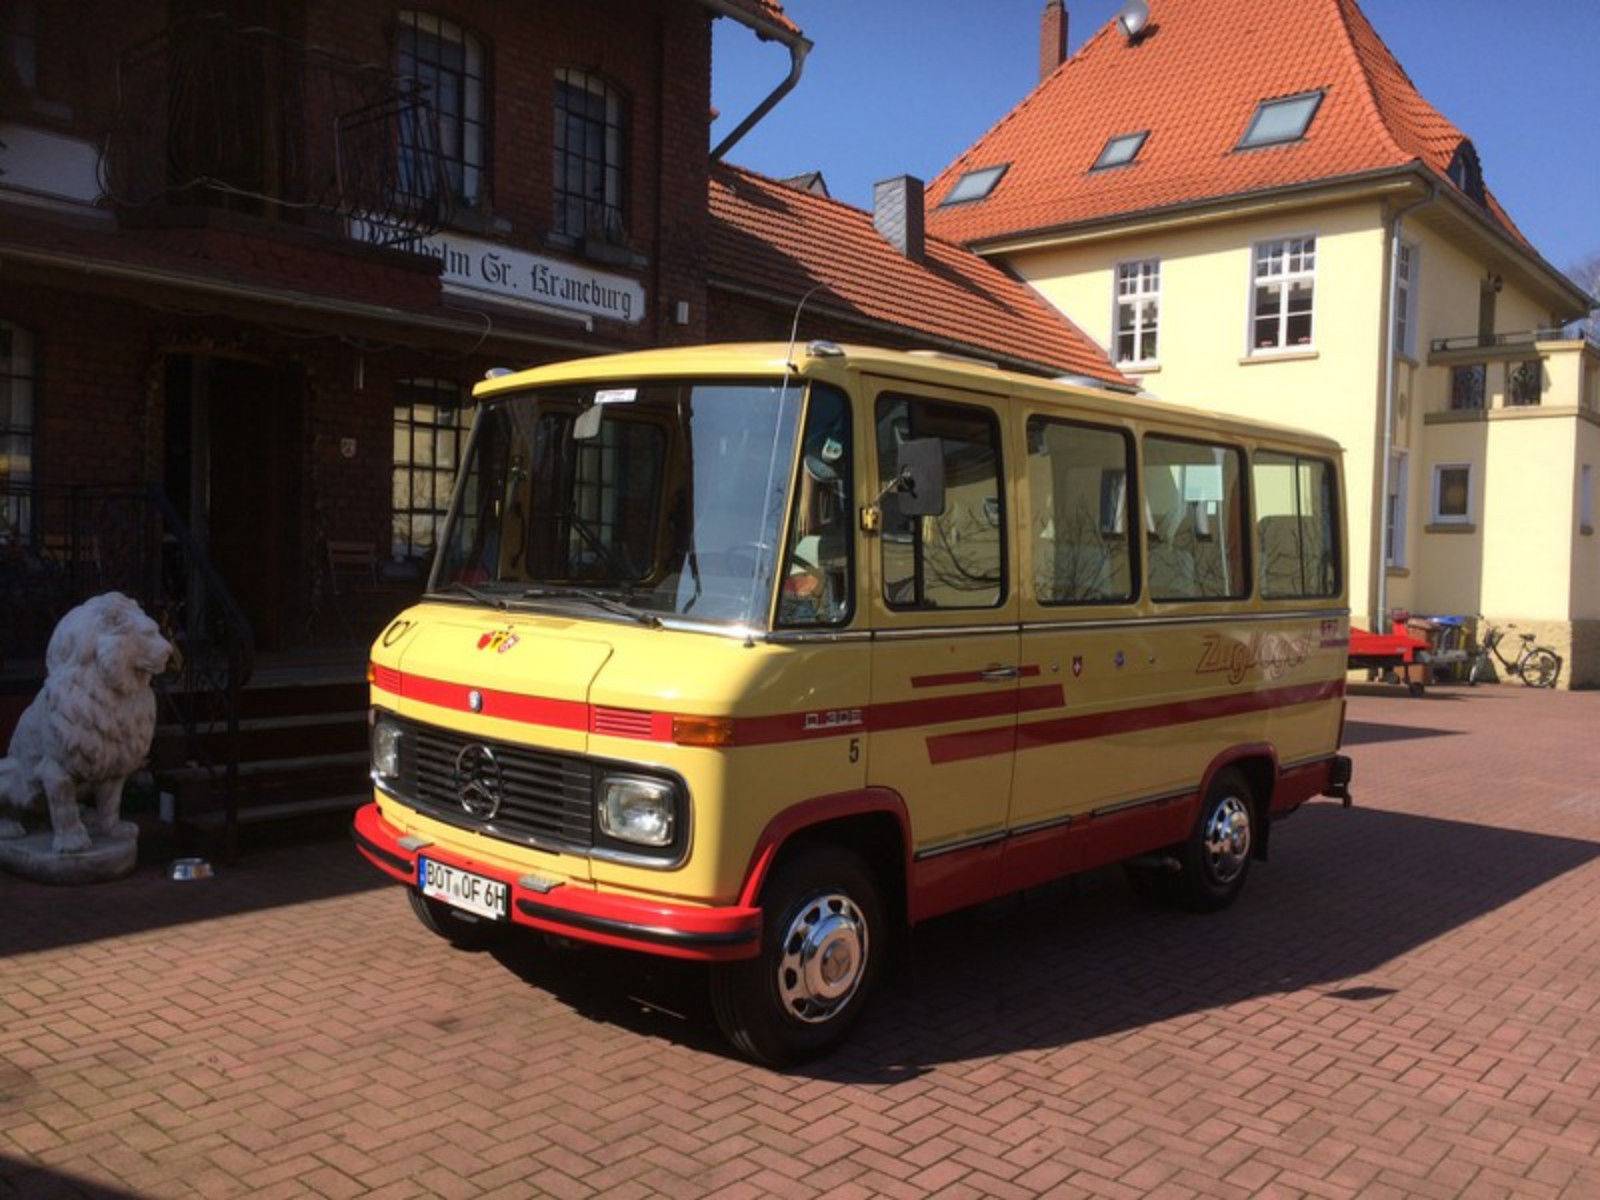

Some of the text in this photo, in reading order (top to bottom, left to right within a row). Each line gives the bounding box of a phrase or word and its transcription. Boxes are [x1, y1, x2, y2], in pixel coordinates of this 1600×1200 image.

[849, 739, 860, 764] 5
[427, 862, 506, 910] BOT OF 6H
